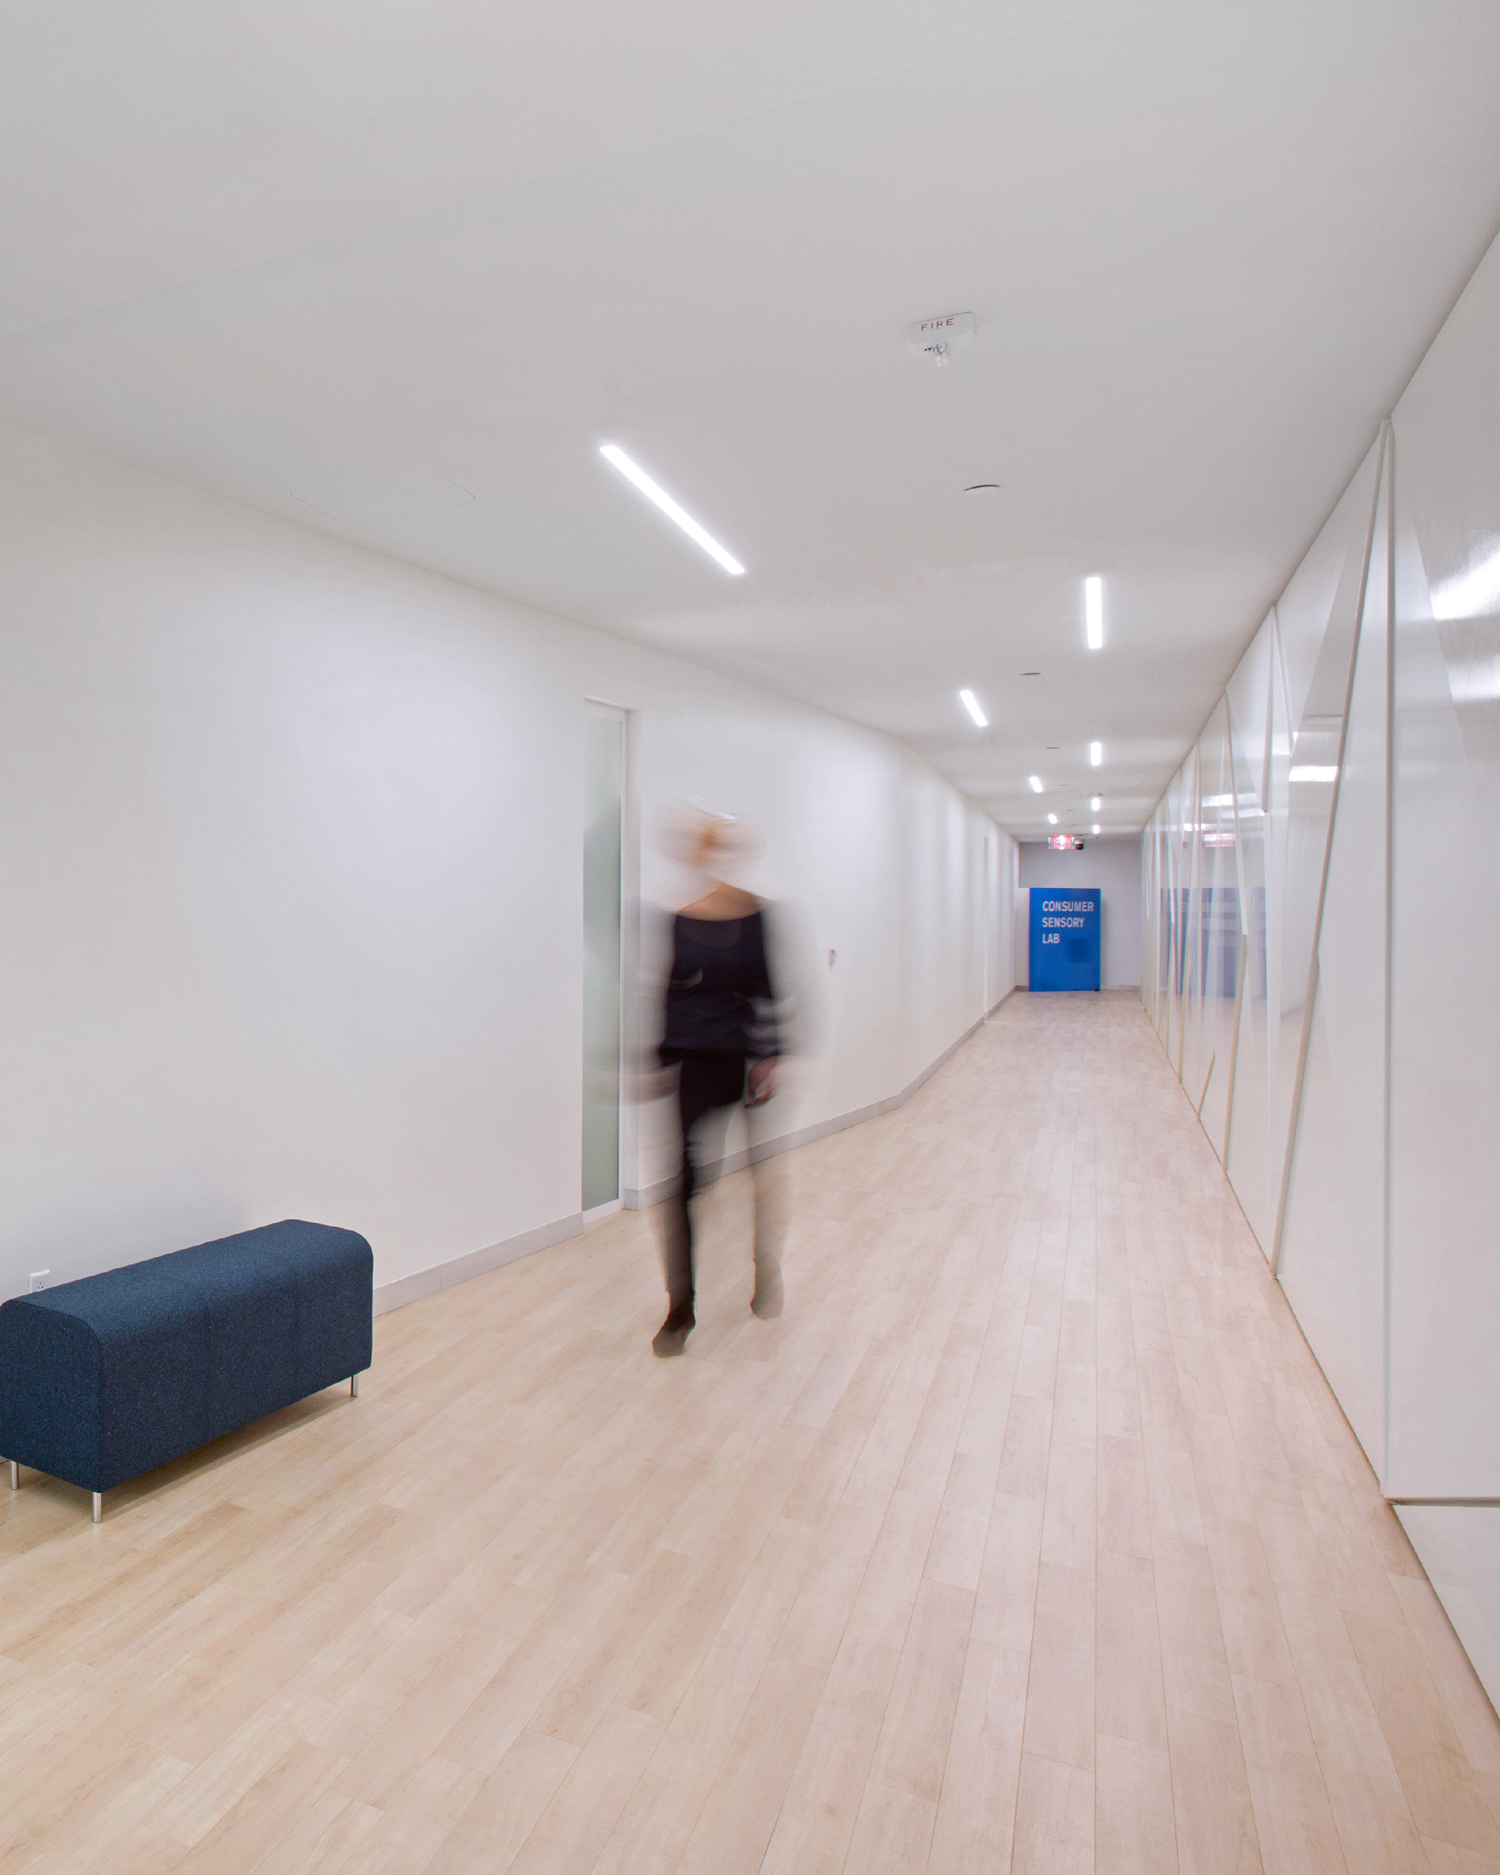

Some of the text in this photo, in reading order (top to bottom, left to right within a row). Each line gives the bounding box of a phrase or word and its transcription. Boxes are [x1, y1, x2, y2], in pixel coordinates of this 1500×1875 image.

[920, 317, 954, 331] FIRE
[1042, 901, 1094, 912] CONSUMER
[1042, 917, 1085, 928] SENSORY
[1042, 933, 1060, 944] LAB
